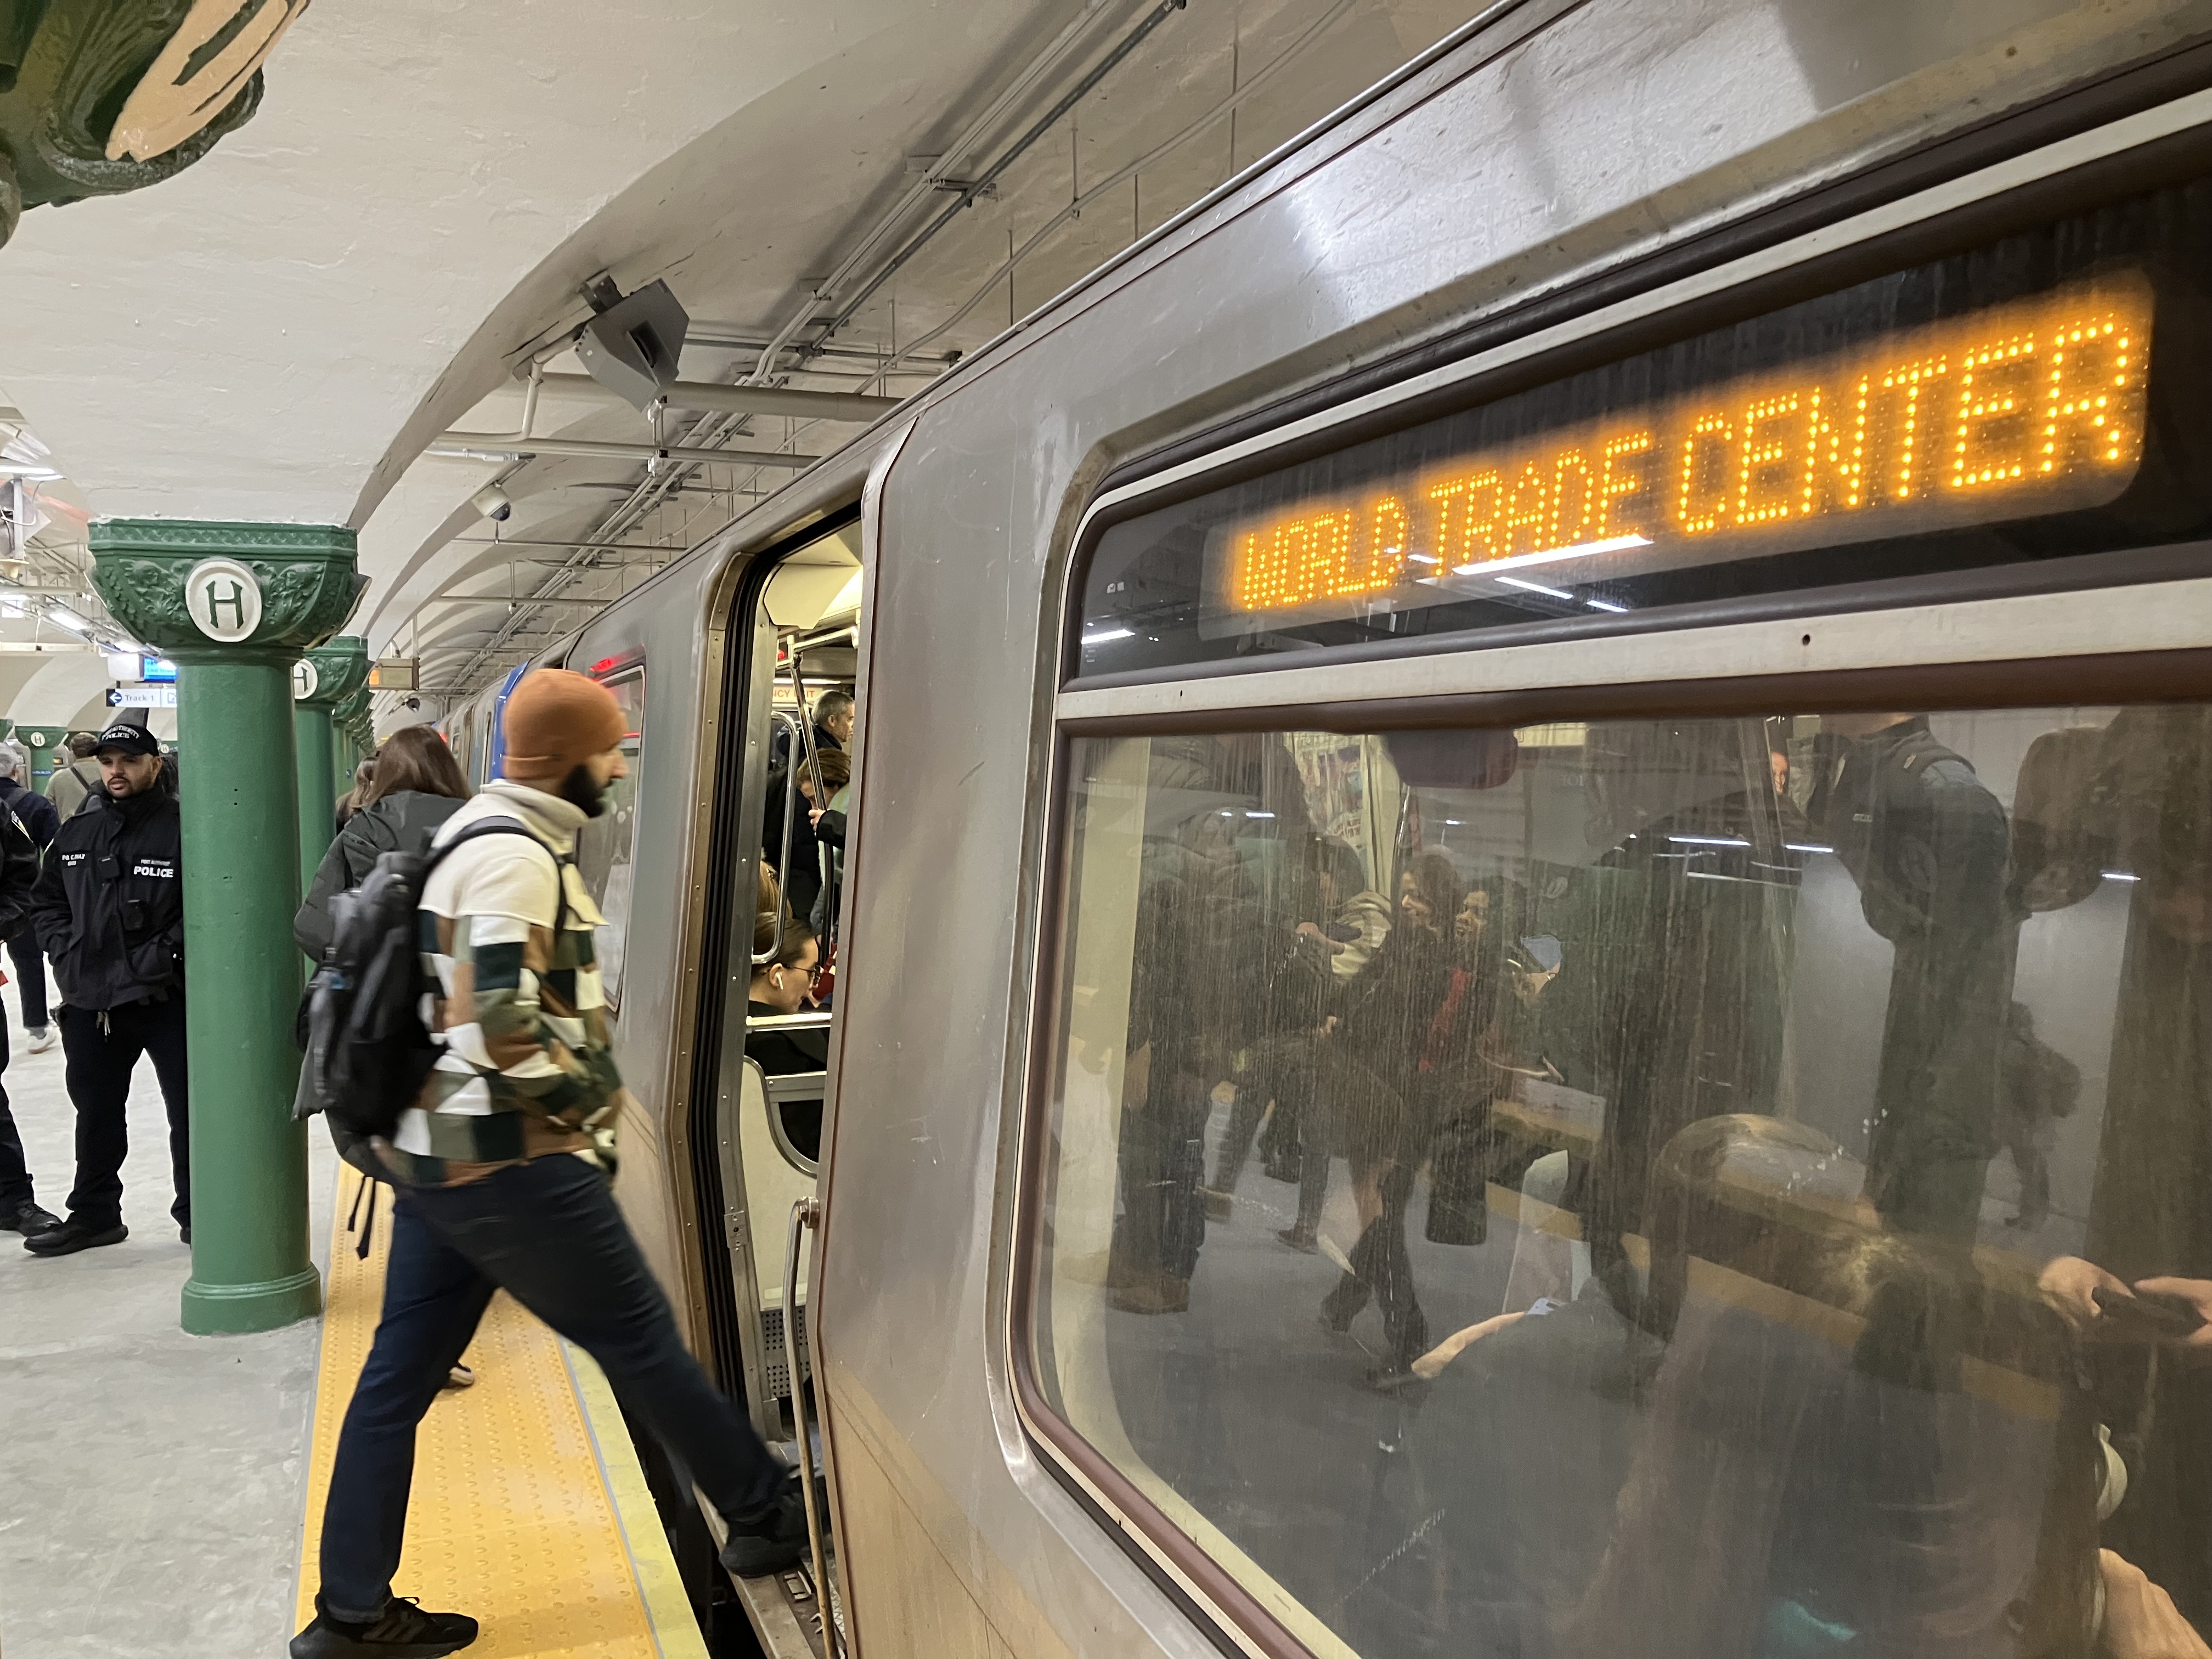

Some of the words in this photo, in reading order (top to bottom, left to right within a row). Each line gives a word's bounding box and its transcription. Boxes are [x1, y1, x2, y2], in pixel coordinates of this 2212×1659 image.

[1244, 495, 1406, 610] WORLD
[1430, 431, 1648, 577] TRADE
[1678, 313, 2130, 534] CENTER
[206, 580, 244, 629] H
[133, 866, 173, 878] POLICE
